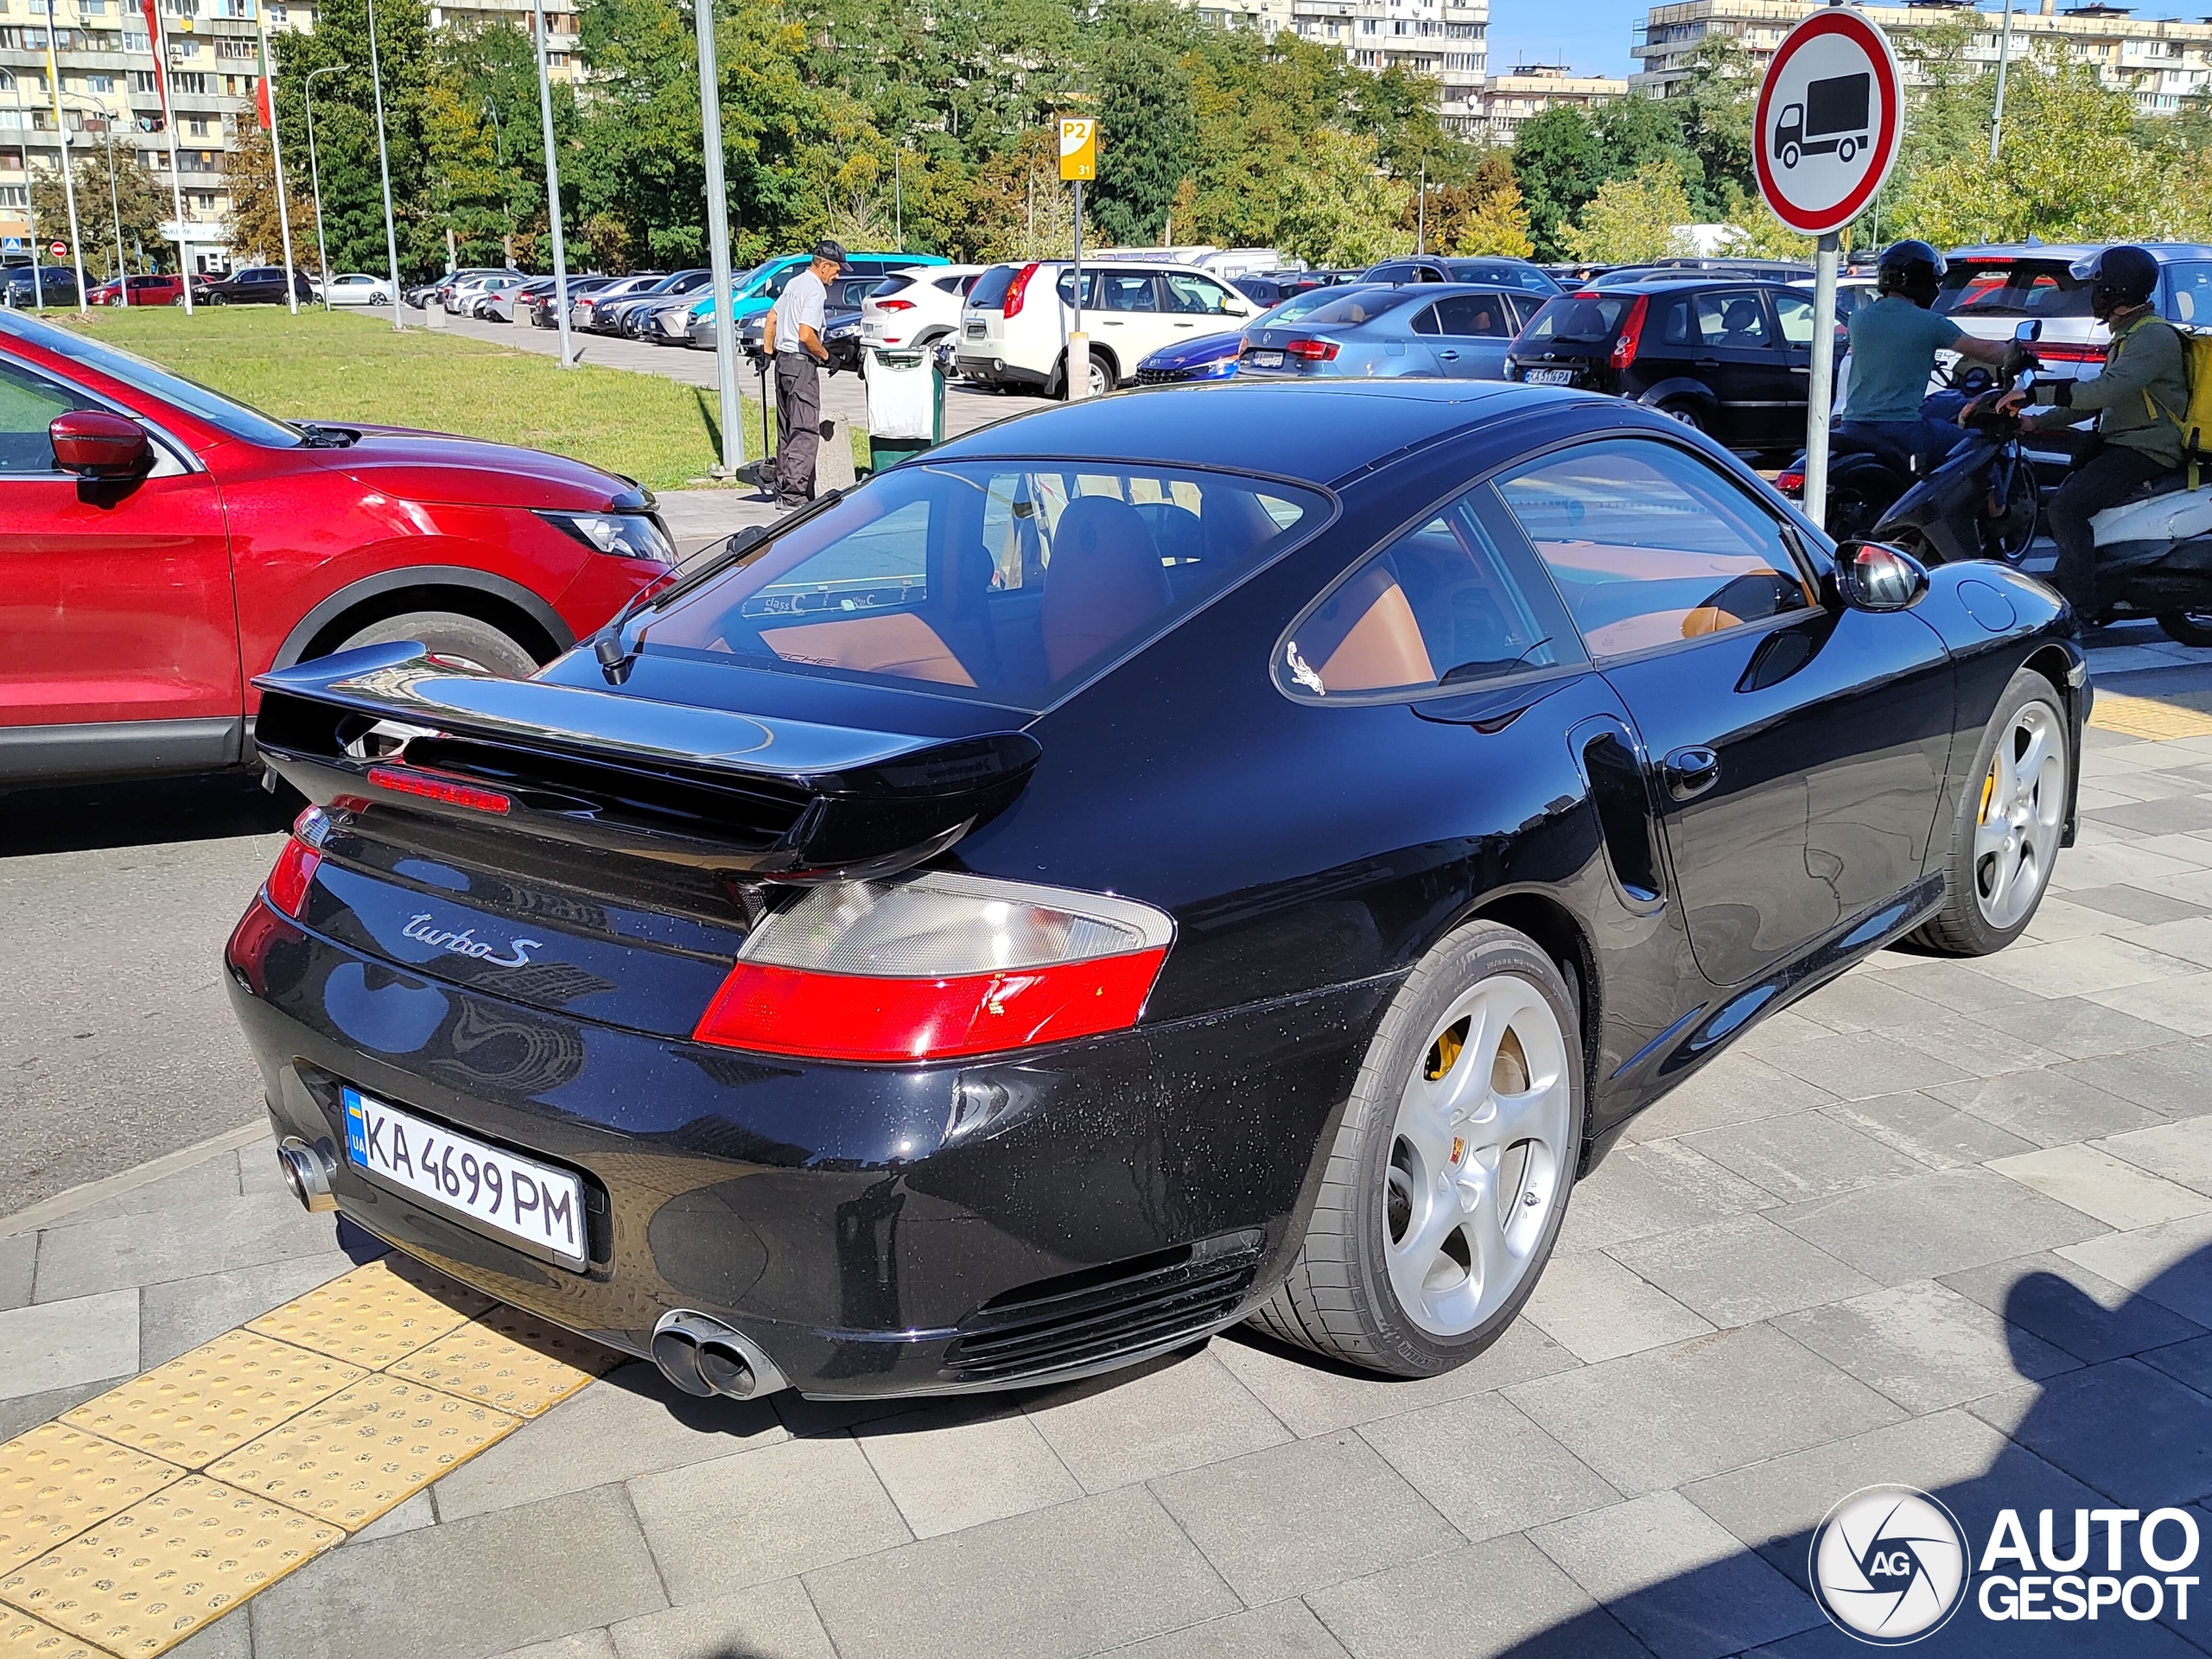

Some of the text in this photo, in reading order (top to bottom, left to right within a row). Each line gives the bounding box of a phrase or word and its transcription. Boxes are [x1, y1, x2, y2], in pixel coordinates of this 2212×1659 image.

[1064, 123, 1085, 138] P2
[1077, 164, 1090, 175] 31
[766, 597, 790, 610] class
[791, 594, 805, 611] C
[401, 912, 490, 957] turbo
[353, 1134, 366, 1154] UA
[365, 1108, 575, 1244] KA 4699 PM
